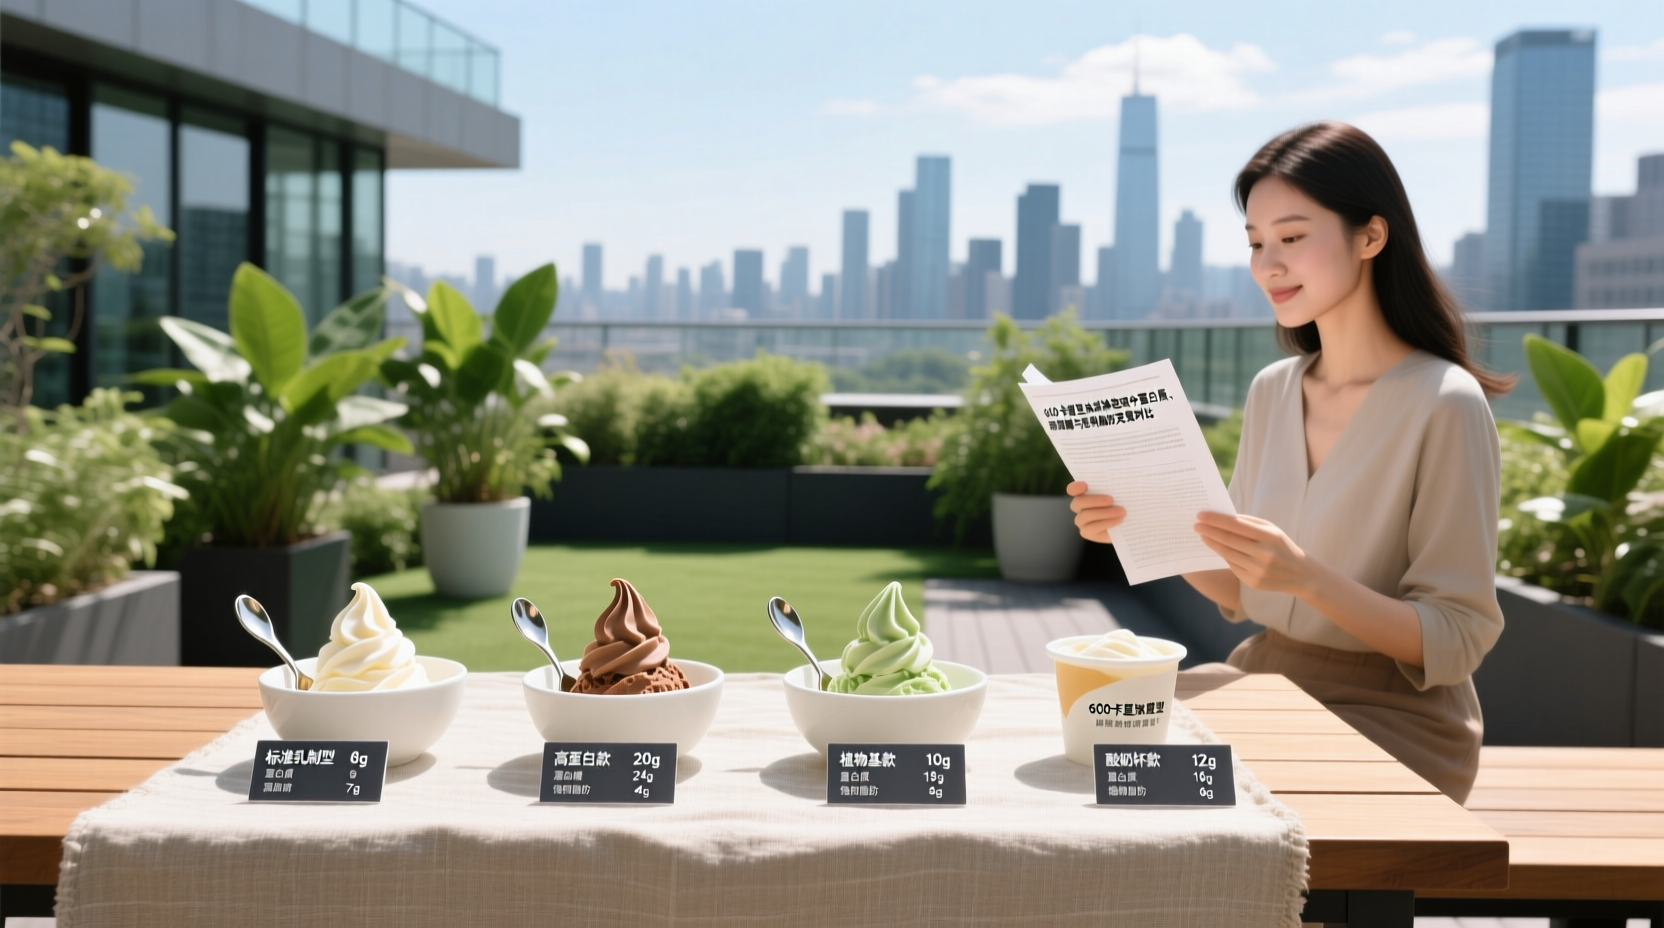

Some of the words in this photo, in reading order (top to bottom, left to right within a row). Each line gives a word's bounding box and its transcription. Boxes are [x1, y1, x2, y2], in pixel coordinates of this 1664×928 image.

[633, 752, 660, 768] 20g
[926, 753, 950, 770] 10g
[1192, 753, 1216, 770] 12g
[632, 770, 653, 783] 24g
